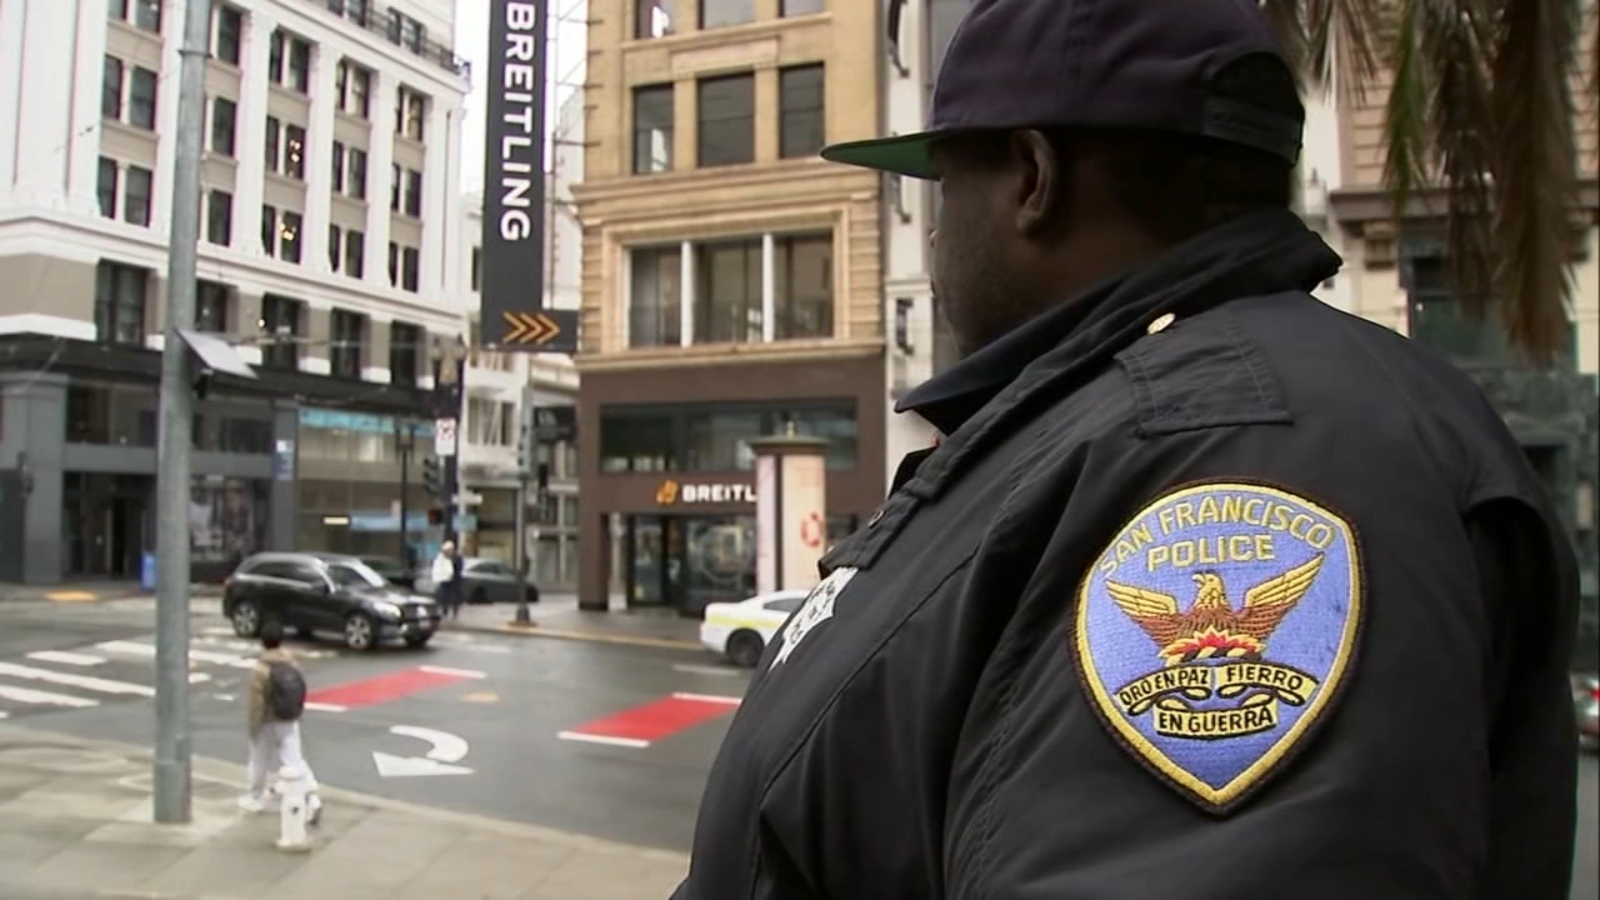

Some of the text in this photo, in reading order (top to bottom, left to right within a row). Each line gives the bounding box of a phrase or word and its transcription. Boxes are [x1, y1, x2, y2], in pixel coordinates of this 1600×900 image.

[500, 1, 535, 241] BREITLING
[1101, 496, 1334, 578] SAN FRANCISCO
[1148, 534, 1275, 571] POLICE
[1119, 666, 1303, 706] ORO EN PAZ FIERRO
[1158, 706, 1273, 733] EN GUERRA
